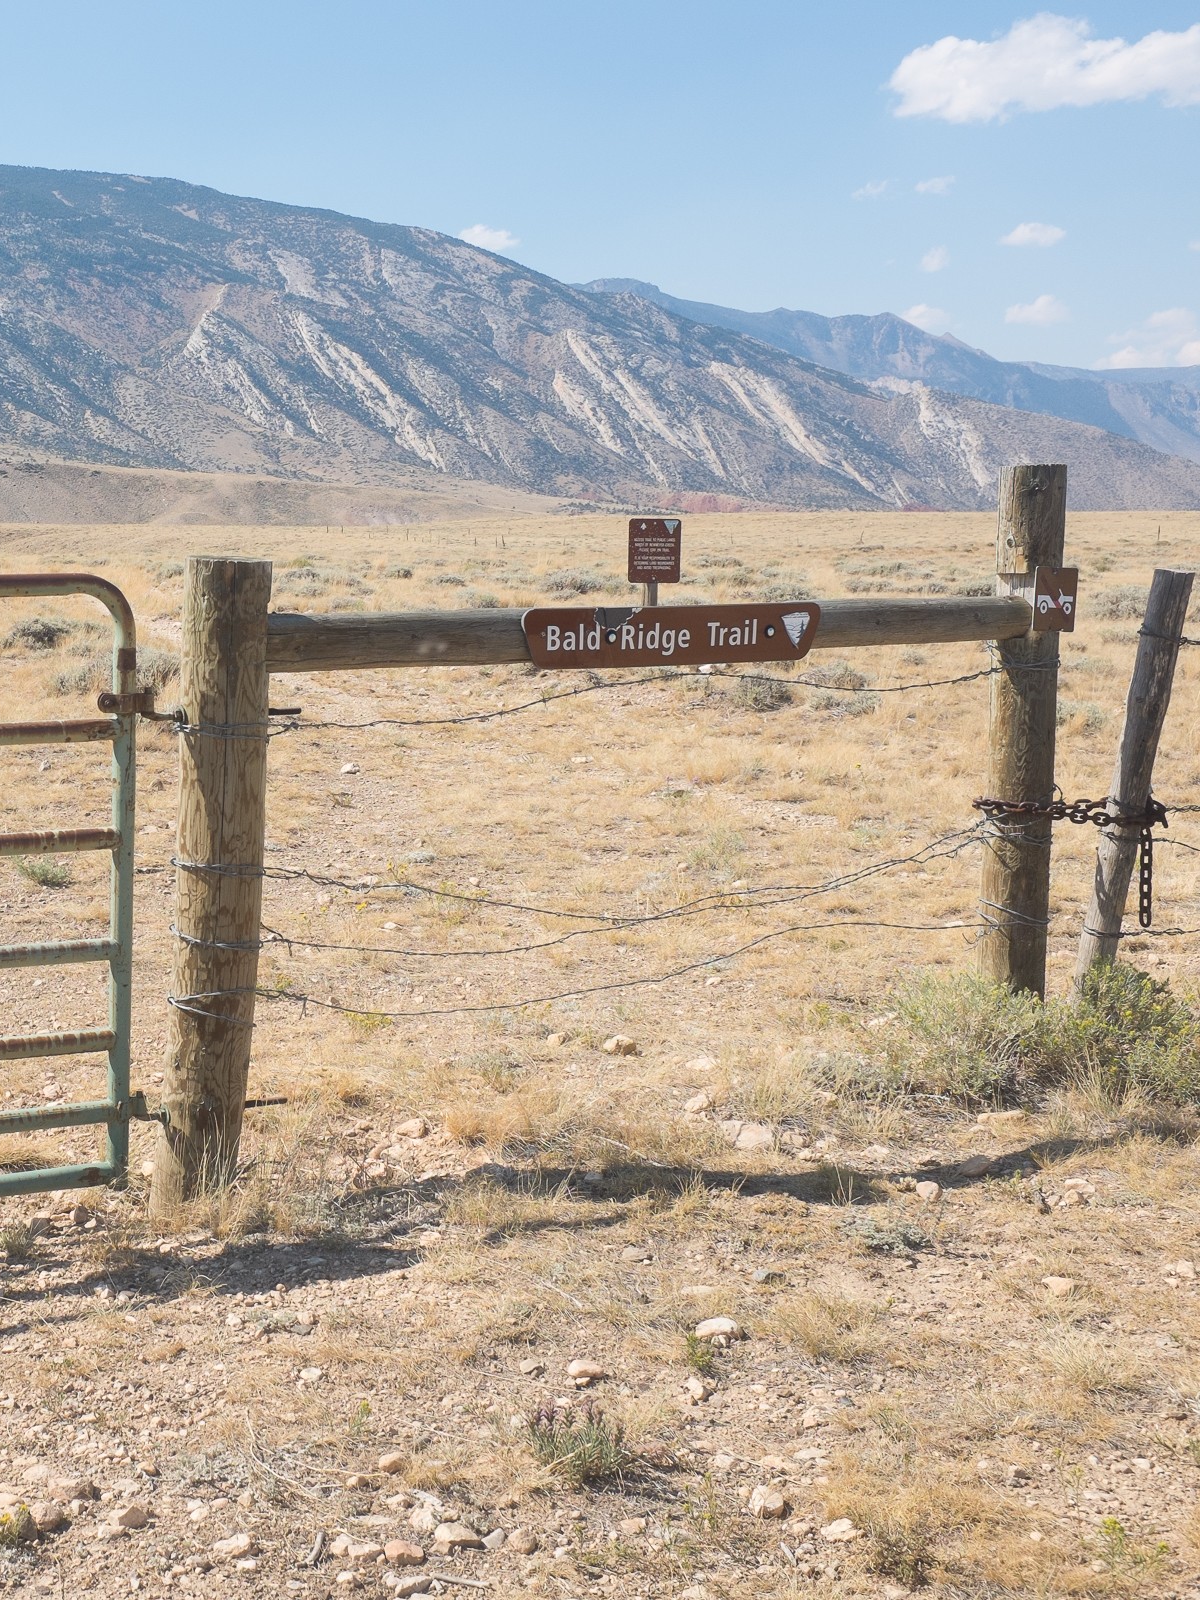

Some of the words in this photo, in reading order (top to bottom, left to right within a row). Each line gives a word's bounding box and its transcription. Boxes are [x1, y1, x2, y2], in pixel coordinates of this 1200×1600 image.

[546, 622, 601, 651] Bald
[620, 623, 691, 656] Ridge
[708, 619, 758, 646] Trail
